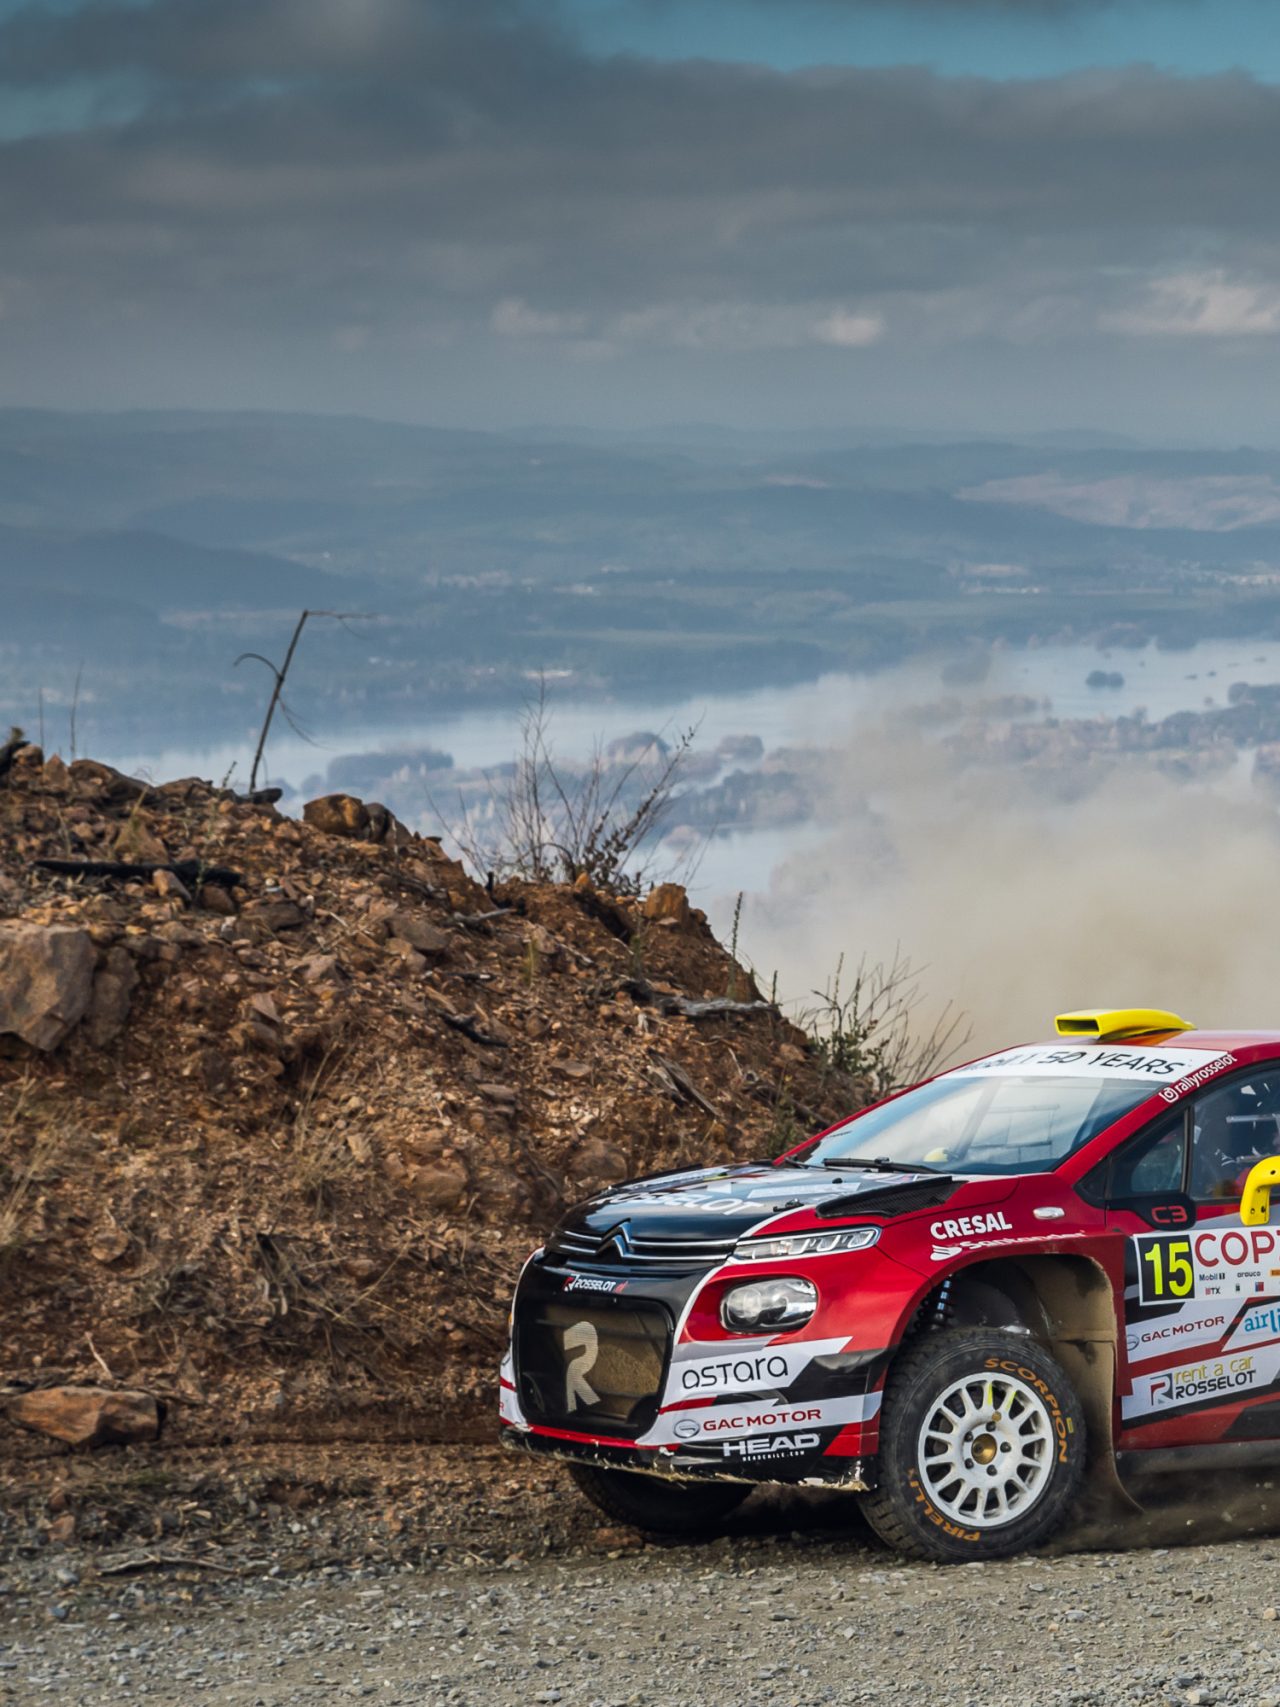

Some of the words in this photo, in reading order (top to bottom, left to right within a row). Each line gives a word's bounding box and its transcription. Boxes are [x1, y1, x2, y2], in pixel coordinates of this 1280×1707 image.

[1037, 1051, 1088, 1064] 50
[1088, 1051, 1186, 1075] YEARS
[1175, 1053, 1238, 1096] rallyrosselot
[930, 1211, 1013, 1240] CRESAL
[1151, 1205, 1188, 1224] C3
[1144, 1241, 1193, 1297] 15
[1141, 1328, 1172, 1343] GAC
[1172, 1315, 1225, 1335] MOTOR
[563, 1321, 601, 1412] R
[681, 1355, 789, 1390] astara
[1174, 1364, 1208, 1385] rent
[1213, 1362, 1224, 1377] a
[1229, 1356, 1254, 1372] car
[1175, 1370, 1257, 1399] ROSSELOT
[703, 1417, 744, 1432] GAC
[746, 1408, 822, 1427] MOTOR
[984, 1358, 1068, 1463] SCORPION
[722, 1432, 821, 1457] HEAD
[909, 1480, 981, 1542] PIRELLI
